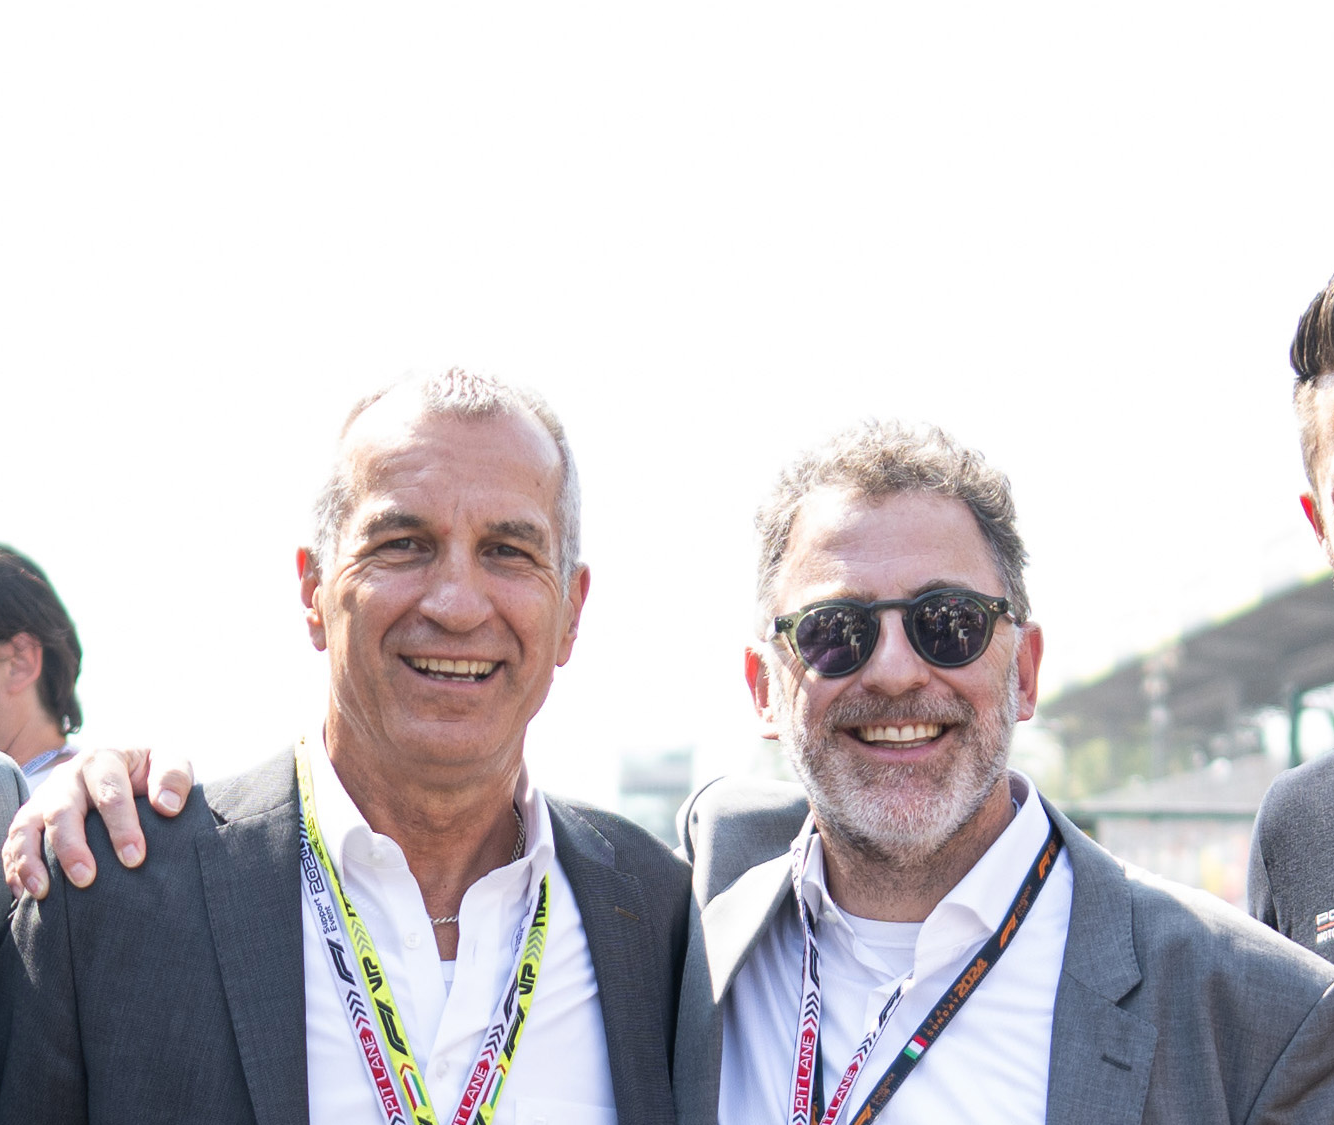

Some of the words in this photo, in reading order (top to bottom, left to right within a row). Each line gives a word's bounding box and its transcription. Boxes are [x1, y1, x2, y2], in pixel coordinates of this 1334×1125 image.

[313, 898, 329, 935] Support
[326, 906, 337, 932] Event
[362, 955, 383, 993] VIP
[519, 962, 537, 996] VIP
[927, 997, 959, 1037] SUNDAY
[362, 1035, 386, 1084] LANE
[798, 1035, 815, 1081] LANE
[380, 1083, 399, 1112] PIT
[461, 1065, 488, 1110] LANE
[794, 1082, 809, 1110] PIT
[830, 1068, 856, 1110] LANE
